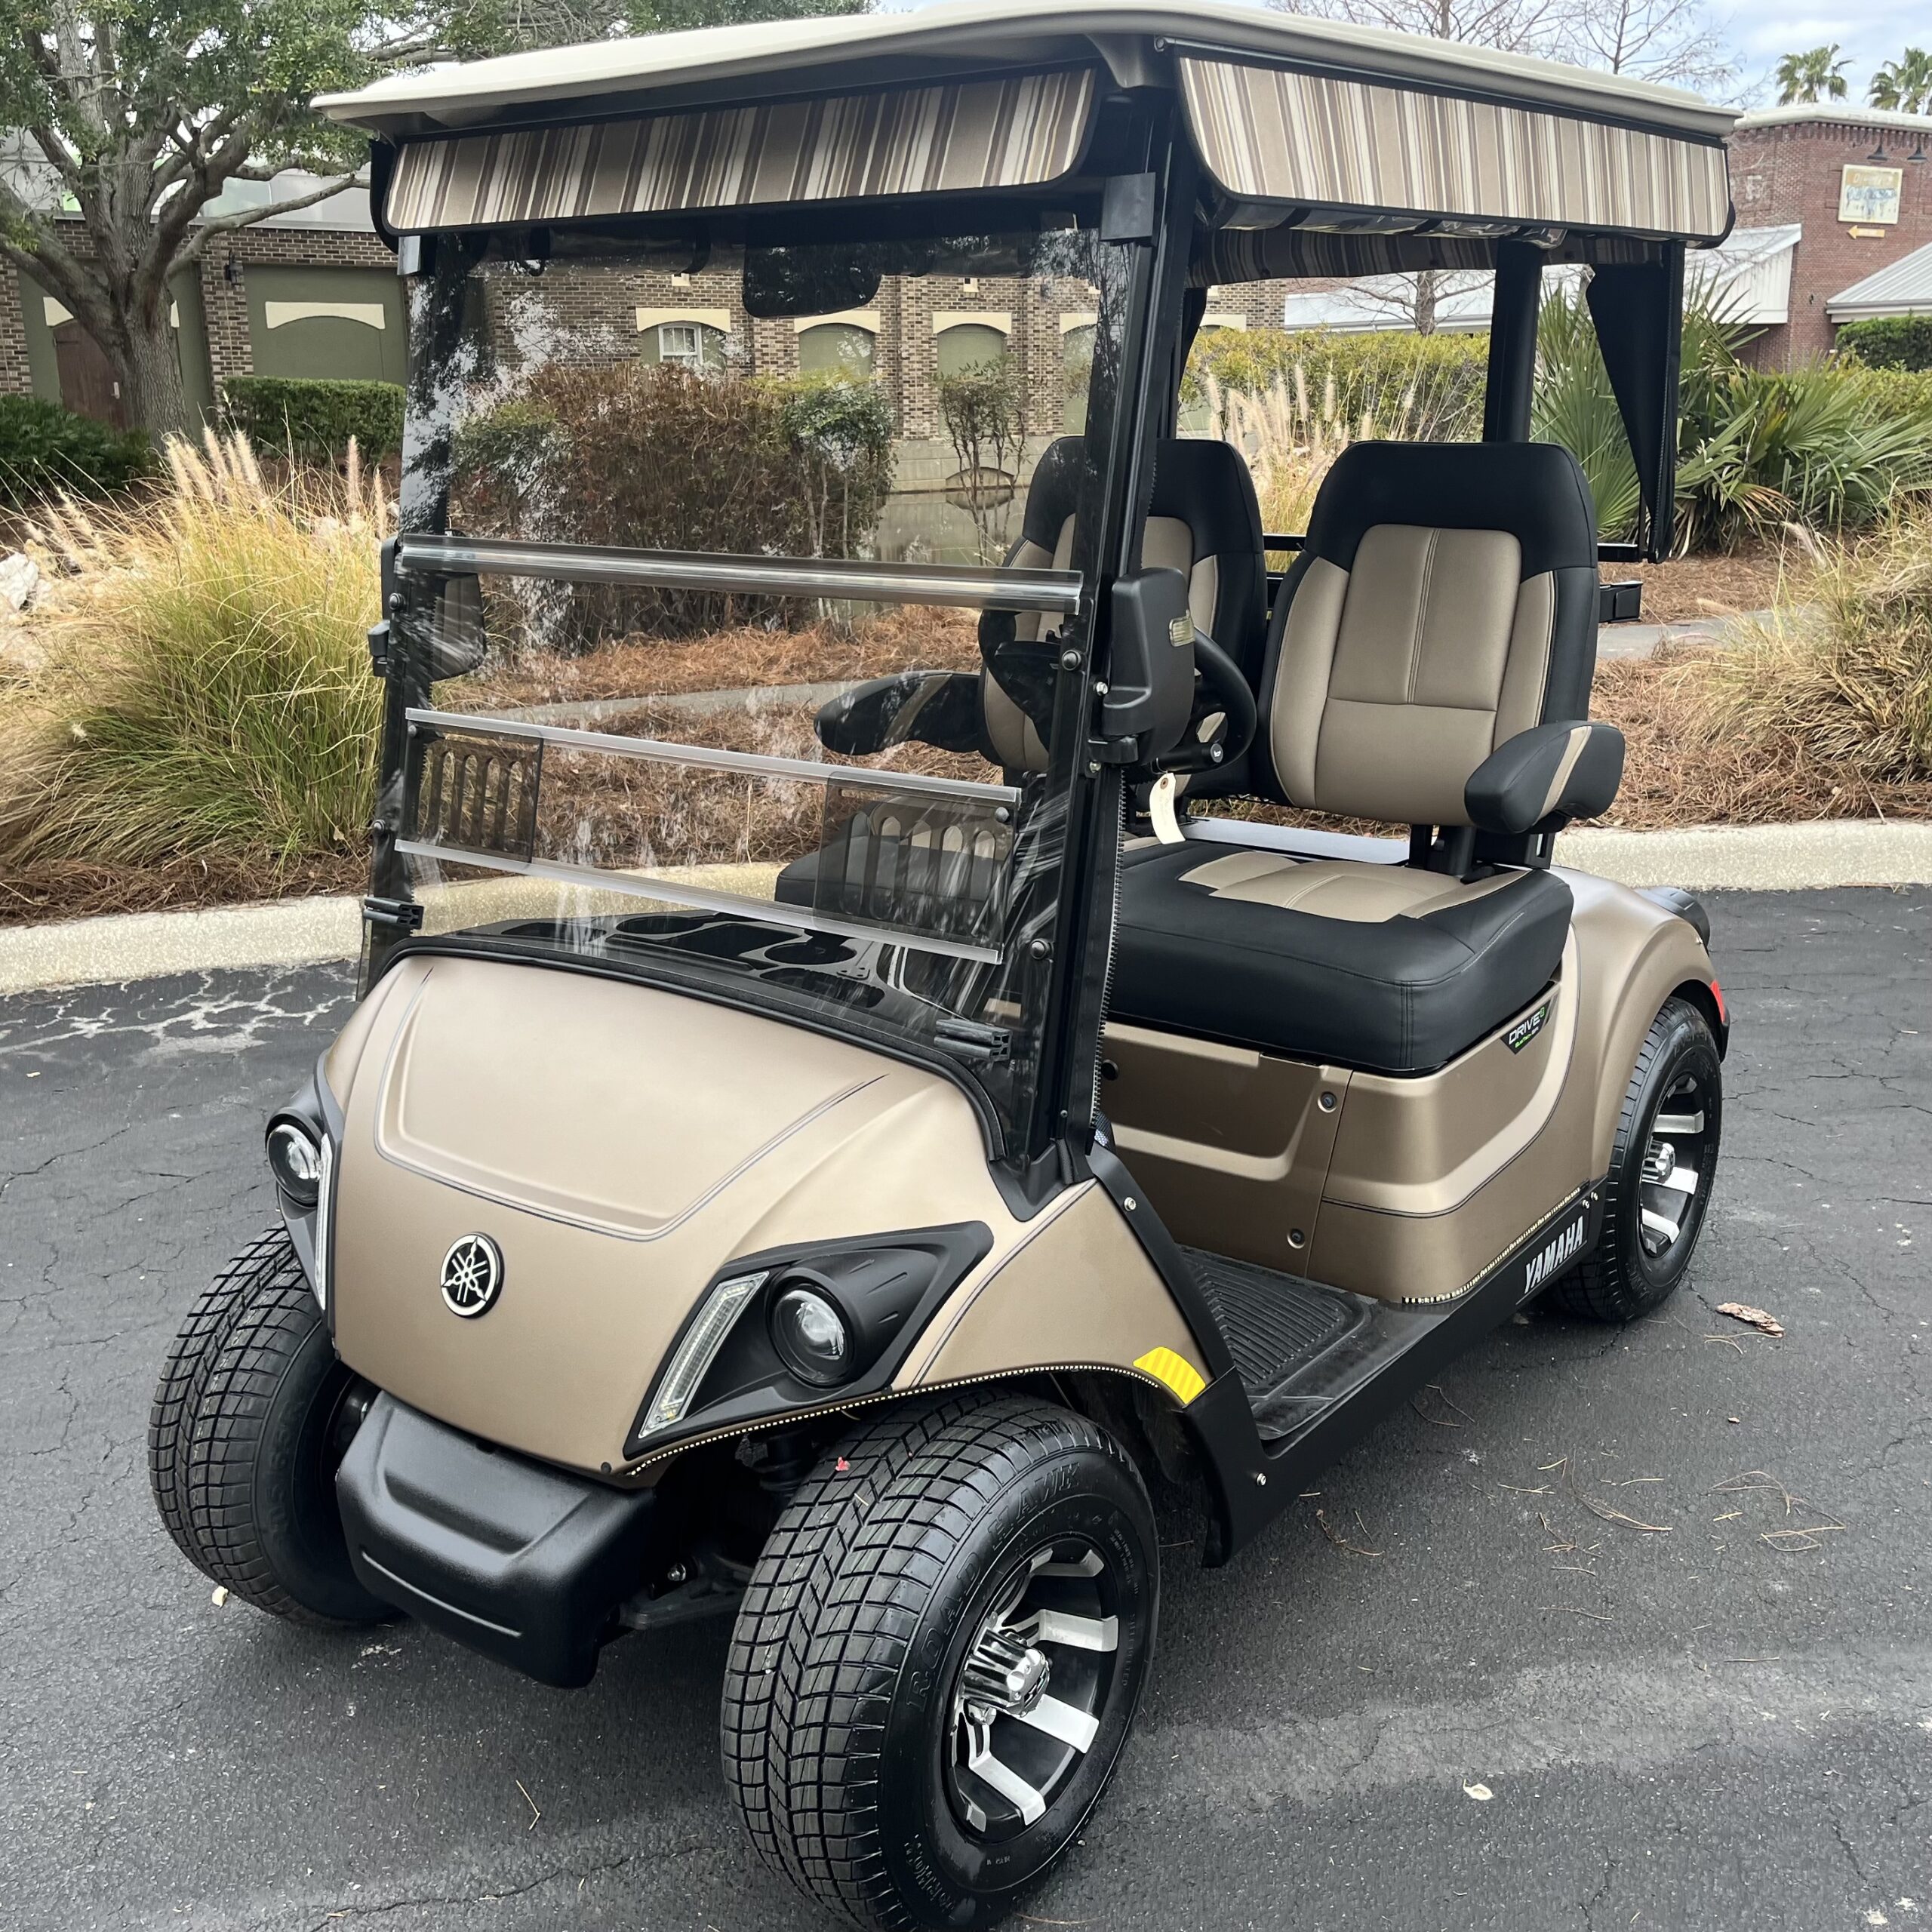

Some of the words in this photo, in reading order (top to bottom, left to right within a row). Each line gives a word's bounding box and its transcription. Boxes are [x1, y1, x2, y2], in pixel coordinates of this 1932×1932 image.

[1524, 1215, 1583, 1294] YAMAHA
[906, 1552, 980, 1712] ROAD
[987, 1461, 1081, 1552] HAWK
